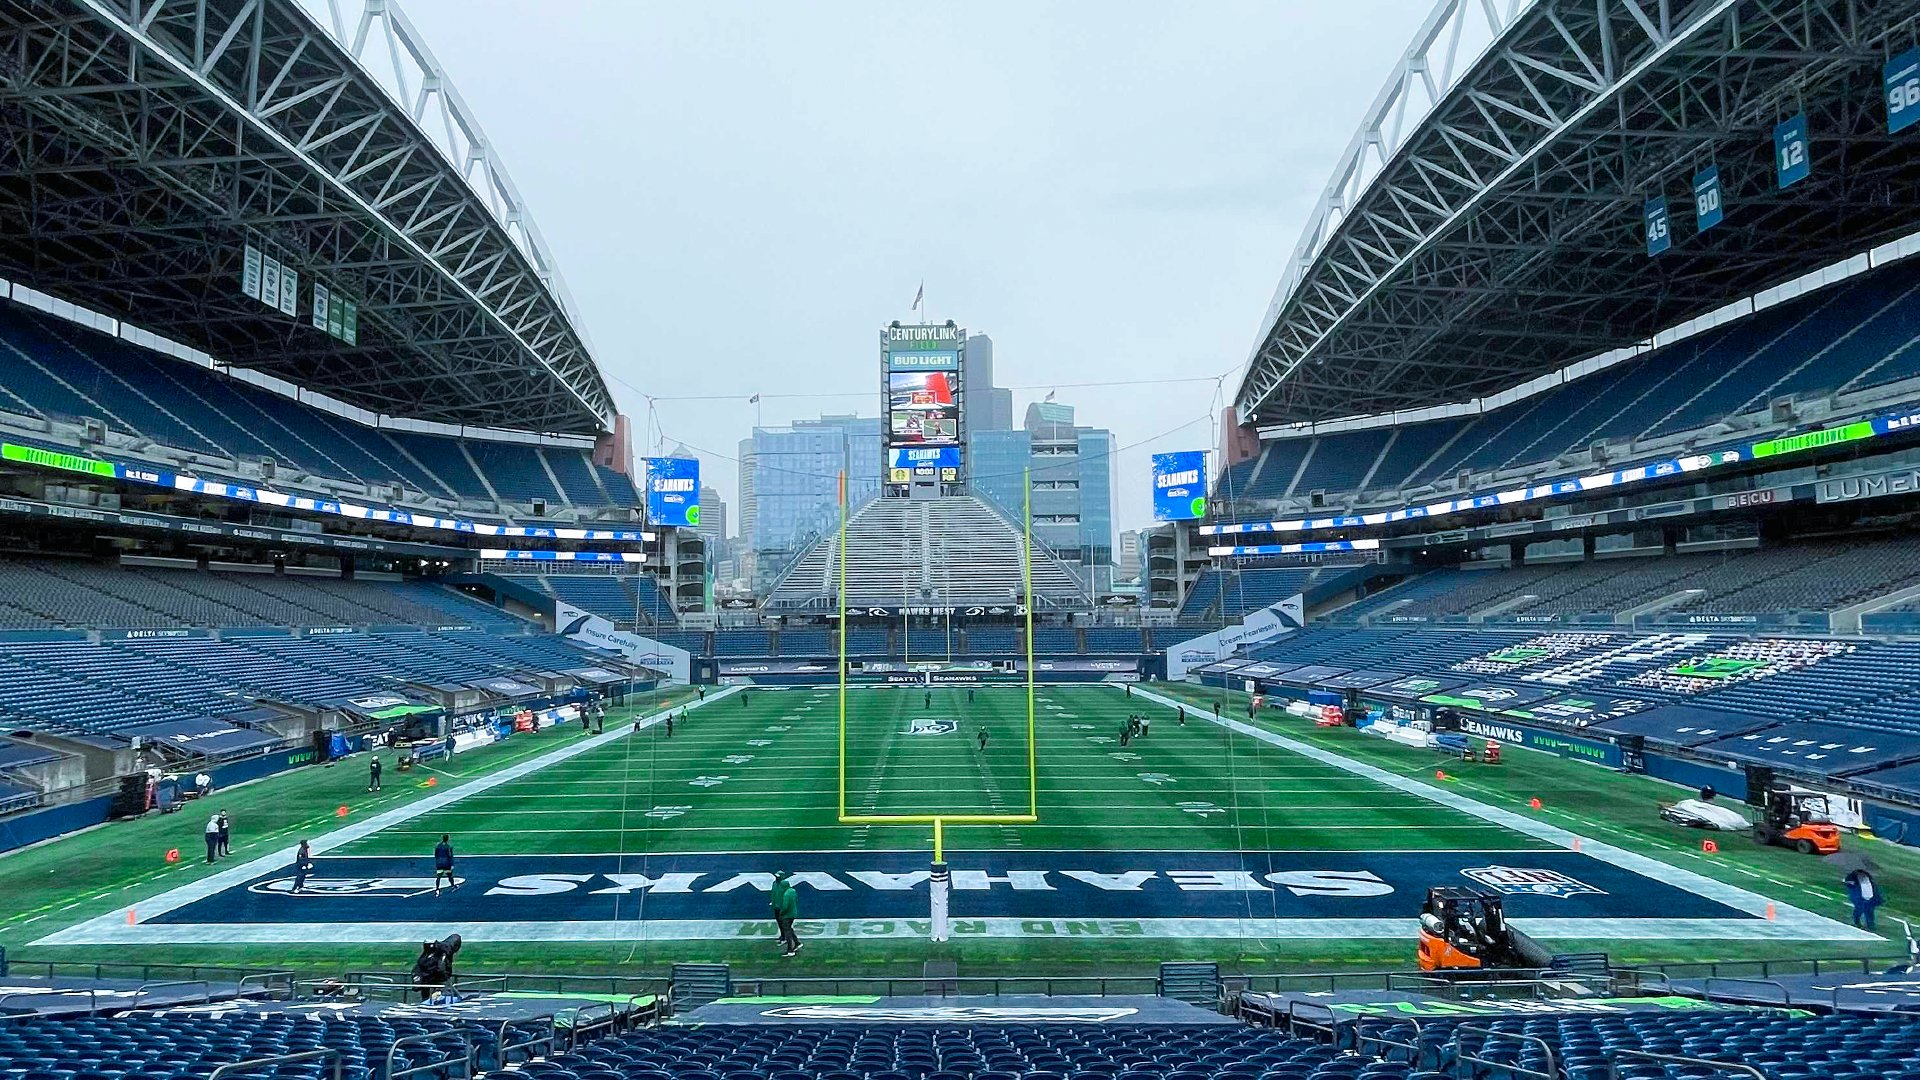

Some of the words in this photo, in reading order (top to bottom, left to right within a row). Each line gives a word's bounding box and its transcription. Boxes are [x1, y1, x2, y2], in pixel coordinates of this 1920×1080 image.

[1889, 77, 1920, 114] 96
[1781, 140, 1803, 171] 12
[1697, 188, 1718, 216] 80
[1648, 217, 1667, 241] 45
[890, 327, 956, 341] CENTURYLINK
[894, 356, 917, 365] BUD
[919, 356, 953, 365] LIGHT
[654, 479, 695, 492] SEAHAWKS
[1157, 469, 1199, 489] SEAHAWKS
[1727, 490, 1772, 508] BECU
[899, 607, 930, 615] HAWKS
[585, 628, 607, 640] Insure
[607, 634, 639, 651] Carefully
[1219, 634, 1243, 647] Dream
[1243, 623, 1278, 639] Fearlessly
[1460, 717, 1523, 742] SEAHAWKS
[482, 870, 1395, 898] SEAHAWKS
[1020, 920, 1146, 937] END
